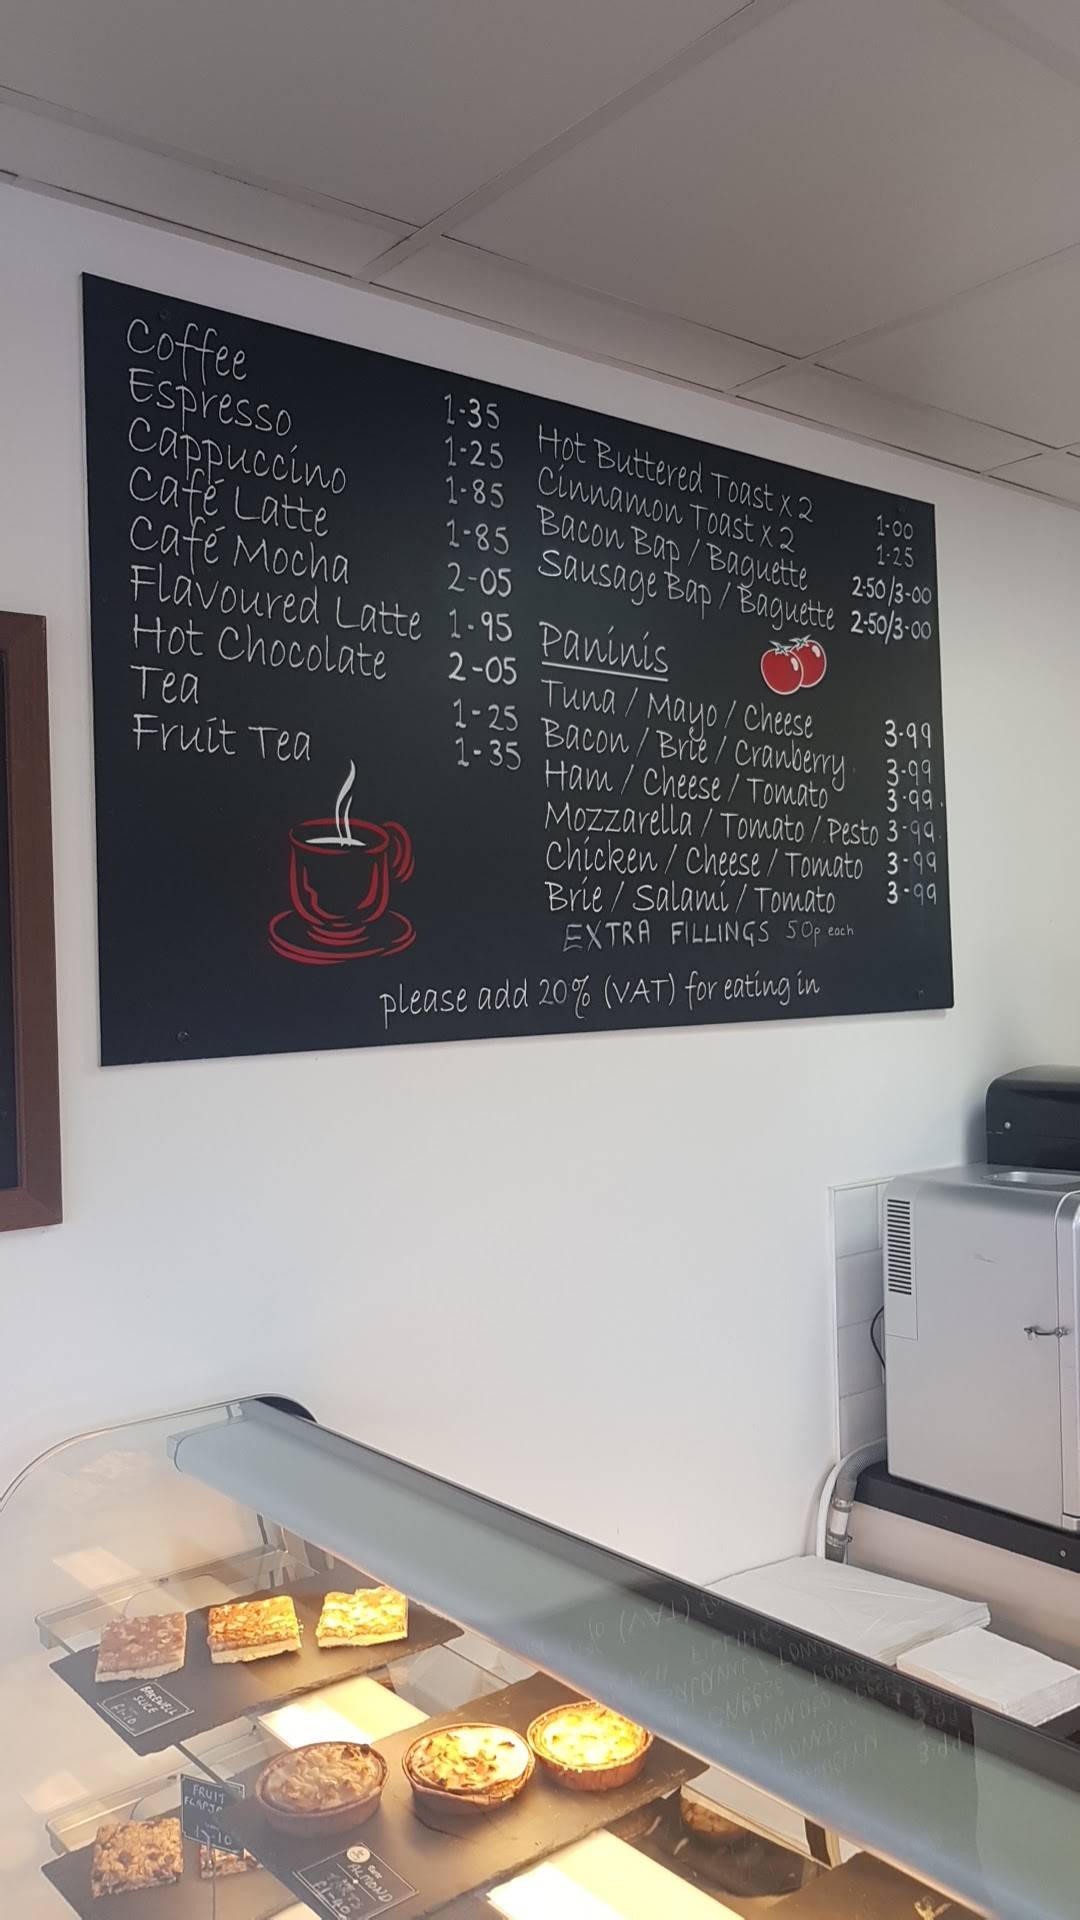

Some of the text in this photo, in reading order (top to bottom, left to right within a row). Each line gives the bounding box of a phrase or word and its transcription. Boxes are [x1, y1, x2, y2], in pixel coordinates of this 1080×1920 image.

[127, 319, 247, 384] Coffee
[129, 368, 291, 436] Espresso
[128, 418, 345, 494] Cappuccino
[538, 424, 586, 464] Hot
[594, 440, 702, 494] Buttered
[711, 472, 773, 512] Toast
[129, 467, 328, 536] Café Latte
[538, 462, 683, 525] Cinnamon
[691, 504, 755, 543] Toast
[130, 516, 349, 583] Café Mocha
[537, 505, 624, 550] Bacon
[632, 526, 680, 566] Bap
[707, 543, 807, 591] Baguette
[131, 565, 422, 640] Flavoured Latte
[538, 550, 656, 606] Sausage
[664, 571, 711, 619] Bap
[737, 585, 835, 631] Baguette
[134, 615, 386, 680] Hot Chocolate
[540, 622, 669, 673] Paninis
[131, 665, 199, 704] Tea
[541, 679, 616, 715] Tuna
[647, 696, 717, 742] Mayo
[744, 704, 813, 739] Cheese
[133, 714, 310, 761] Fruit Tea
[541, 718, 628, 755] Bacon
[656, 730, 707, 764] Brie
[735, 740, 845, 791] Cranberry
[546, 760, 614, 792] Ham
[643, 767, 720, 803] Cheese
[747, 778, 828, 809] Tomato
[545, 802, 692, 836] Mozzarella
[720, 812, 805, 843] Tomato
[827, 818, 879, 847] Pesto
[546, 837, 658, 874] Chicken
[686, 843, 761, 878] Cheese
[785, 852, 863, 879] Tomato
[545, 877, 604, 913] Brie
[633, 878, 730, 911] Salami
[754, 886, 835, 914] Tomato
[562, 920, 854, 951] EXTRA FILLINGS 50p each
[379, 967, 820, 1029] please add 20% (VAT) for eating in
[193, 1783, 224, 1805] FRUIT
[348, 1863, 393, 1903] ALMOND
